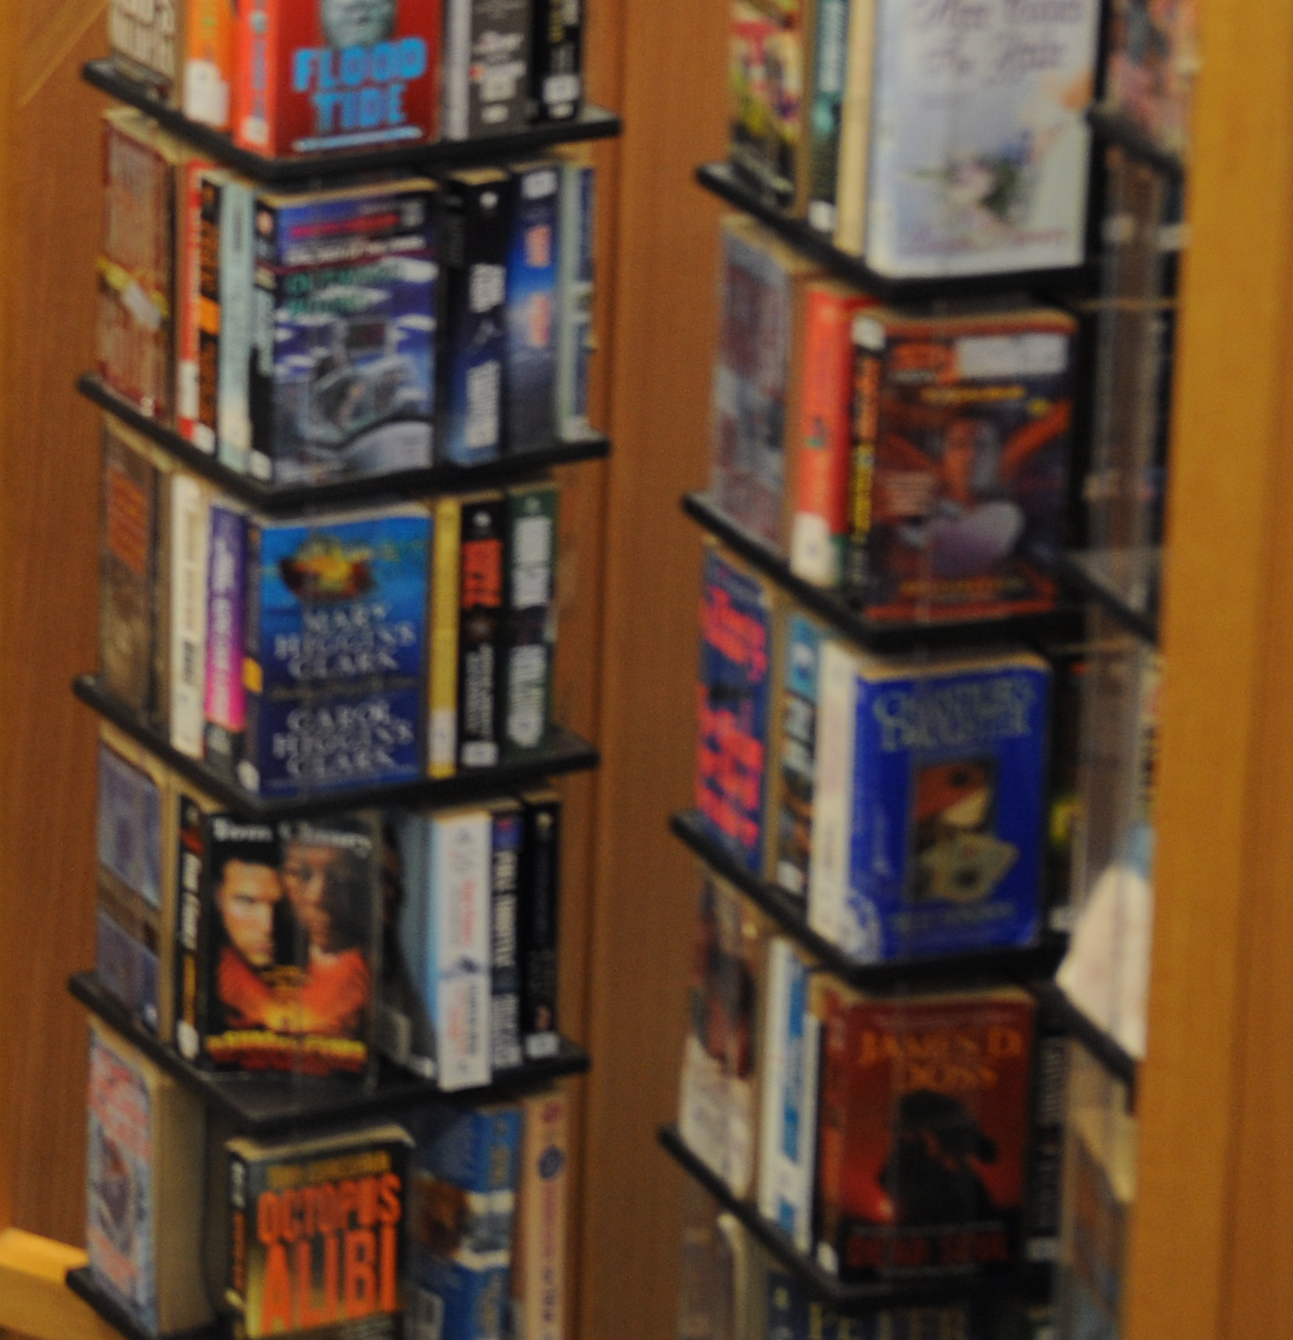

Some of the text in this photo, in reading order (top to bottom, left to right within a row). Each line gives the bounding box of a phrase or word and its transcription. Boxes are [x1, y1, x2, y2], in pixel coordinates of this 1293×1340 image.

[293, 36, 428, 94] FLOOD
[311, 81, 407, 133] TIDE
[287, 650, 398, 682] CLARK
[286, 748, 396, 780] CLARK
[213, 816, 273, 843] Tom
[257, 1172, 402, 1244] OCTOPUS
[261, 1223, 398, 1335] ALIBI
